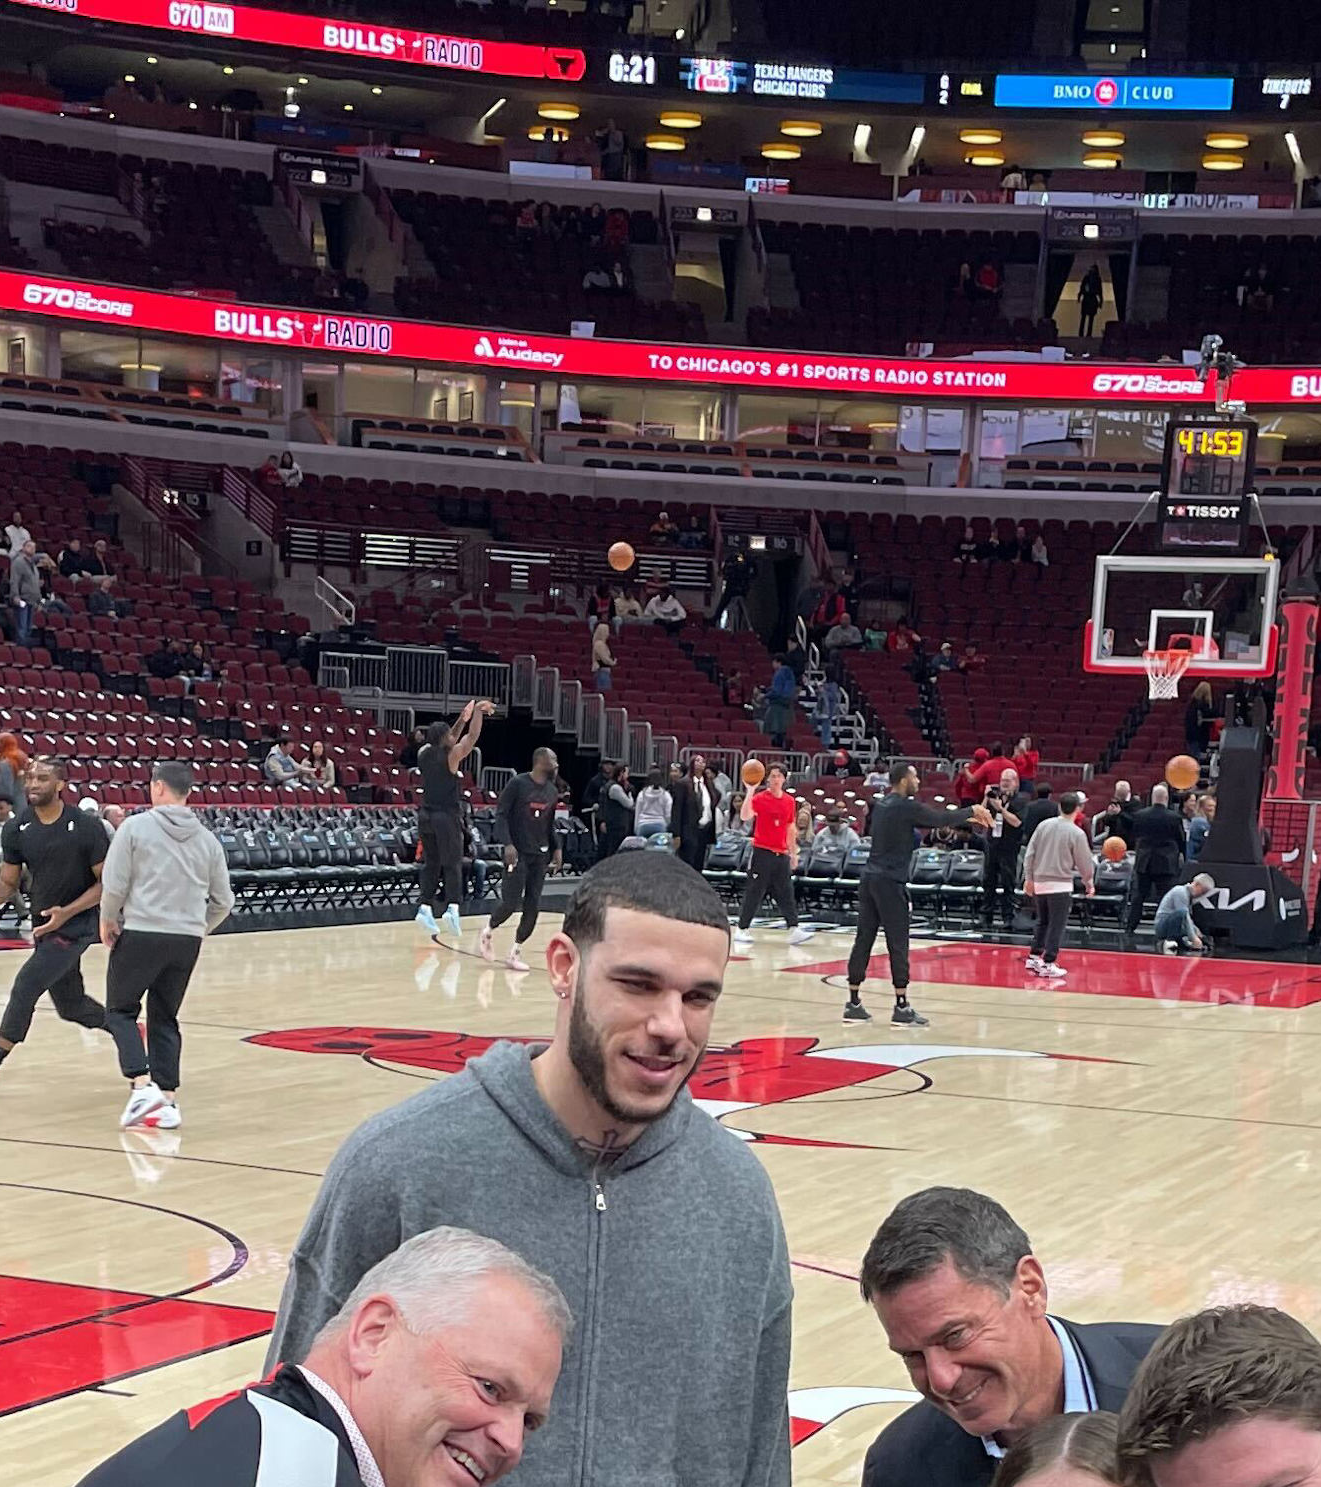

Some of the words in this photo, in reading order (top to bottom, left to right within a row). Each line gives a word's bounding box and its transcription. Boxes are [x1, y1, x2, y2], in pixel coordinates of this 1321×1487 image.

[168, 1, 203, 28] 670
[324, 25, 397, 54] BULLS
[424, 37, 483, 71] RADIO
[609, 53, 655, 84] 6:21
[754, 63, 786, 80] TEXAS
[786, 66, 833, 84] RANGERS
[753, 79, 797, 96] CHICAGO
[798, 83, 826, 98] CUBS
[1053, 85, 1091, 99] BMO
[1132, 87, 1174, 100] CLUB
[23, 283, 76, 309] 670
[74, 297, 134, 317] SCORE
[214, 309, 294, 340] BULLS
[324, 318, 392, 352] RADIO
[497, 346, 564, 367] Audacy
[648, 354, 672, 369] TO
[676, 356, 771, 376] CHICAGO'S
[776, 363, 799, 378] #1
[803, 364, 870, 382] SPORTS
[874, 368, 928, 385] RADIO
[933, 370, 1006, 388] STATION
[1092, 373, 1144, 392] 670
[1144, 379, 1205, 394] SCORE
[1178, 429, 1244, 456] 41:53
[1186, 505, 1240, 519] TISSOT
